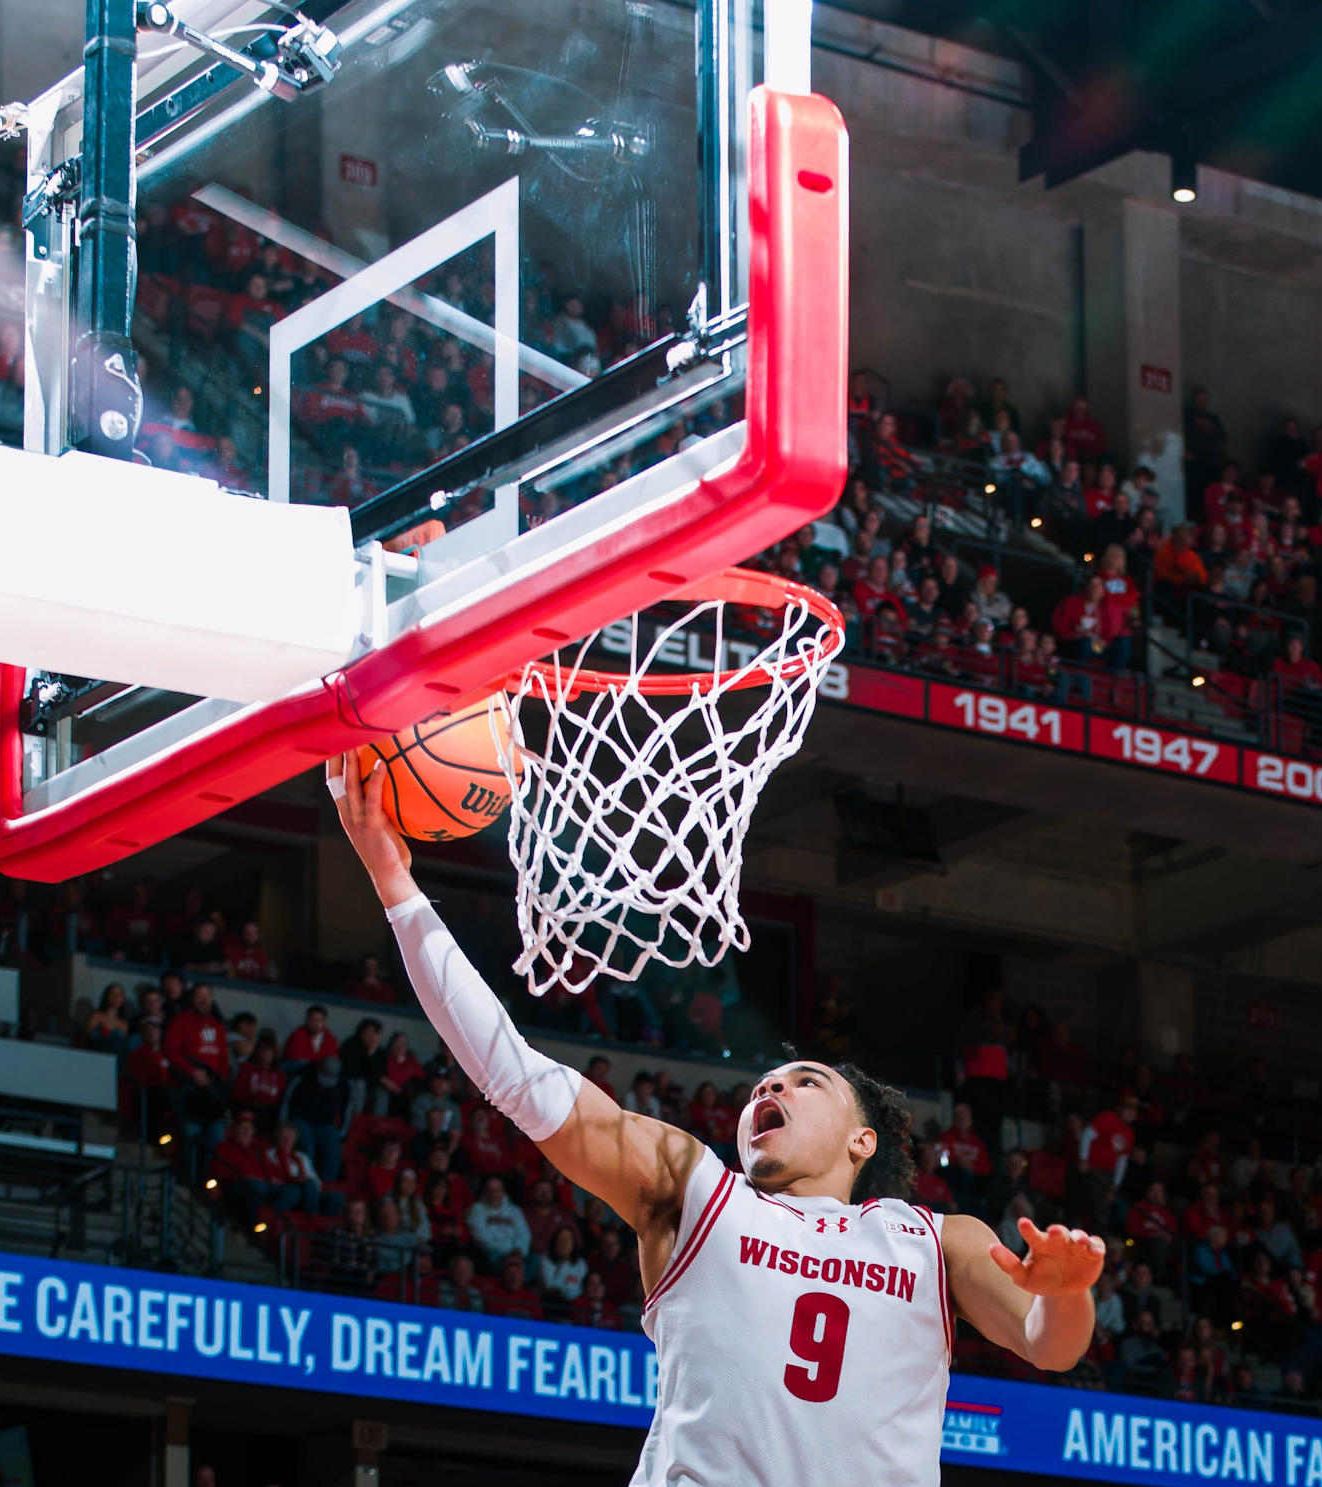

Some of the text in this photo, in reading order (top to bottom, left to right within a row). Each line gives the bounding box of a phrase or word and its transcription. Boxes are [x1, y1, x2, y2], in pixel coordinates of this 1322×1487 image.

[954, 692, 1062, 745] 1941
[1112, 724, 1219, 775] 1947
[740, 1235, 917, 1304] WISCONSIN
[35, 1275, 316, 1375] CAREFULLY,
[331, 1312, 494, 1389] DREAM
[783, 1291, 851, 1403] 9
[945, 1411, 1001, 1435] AMILY
[1062, 1408, 1275, 1484] AMERICAN
